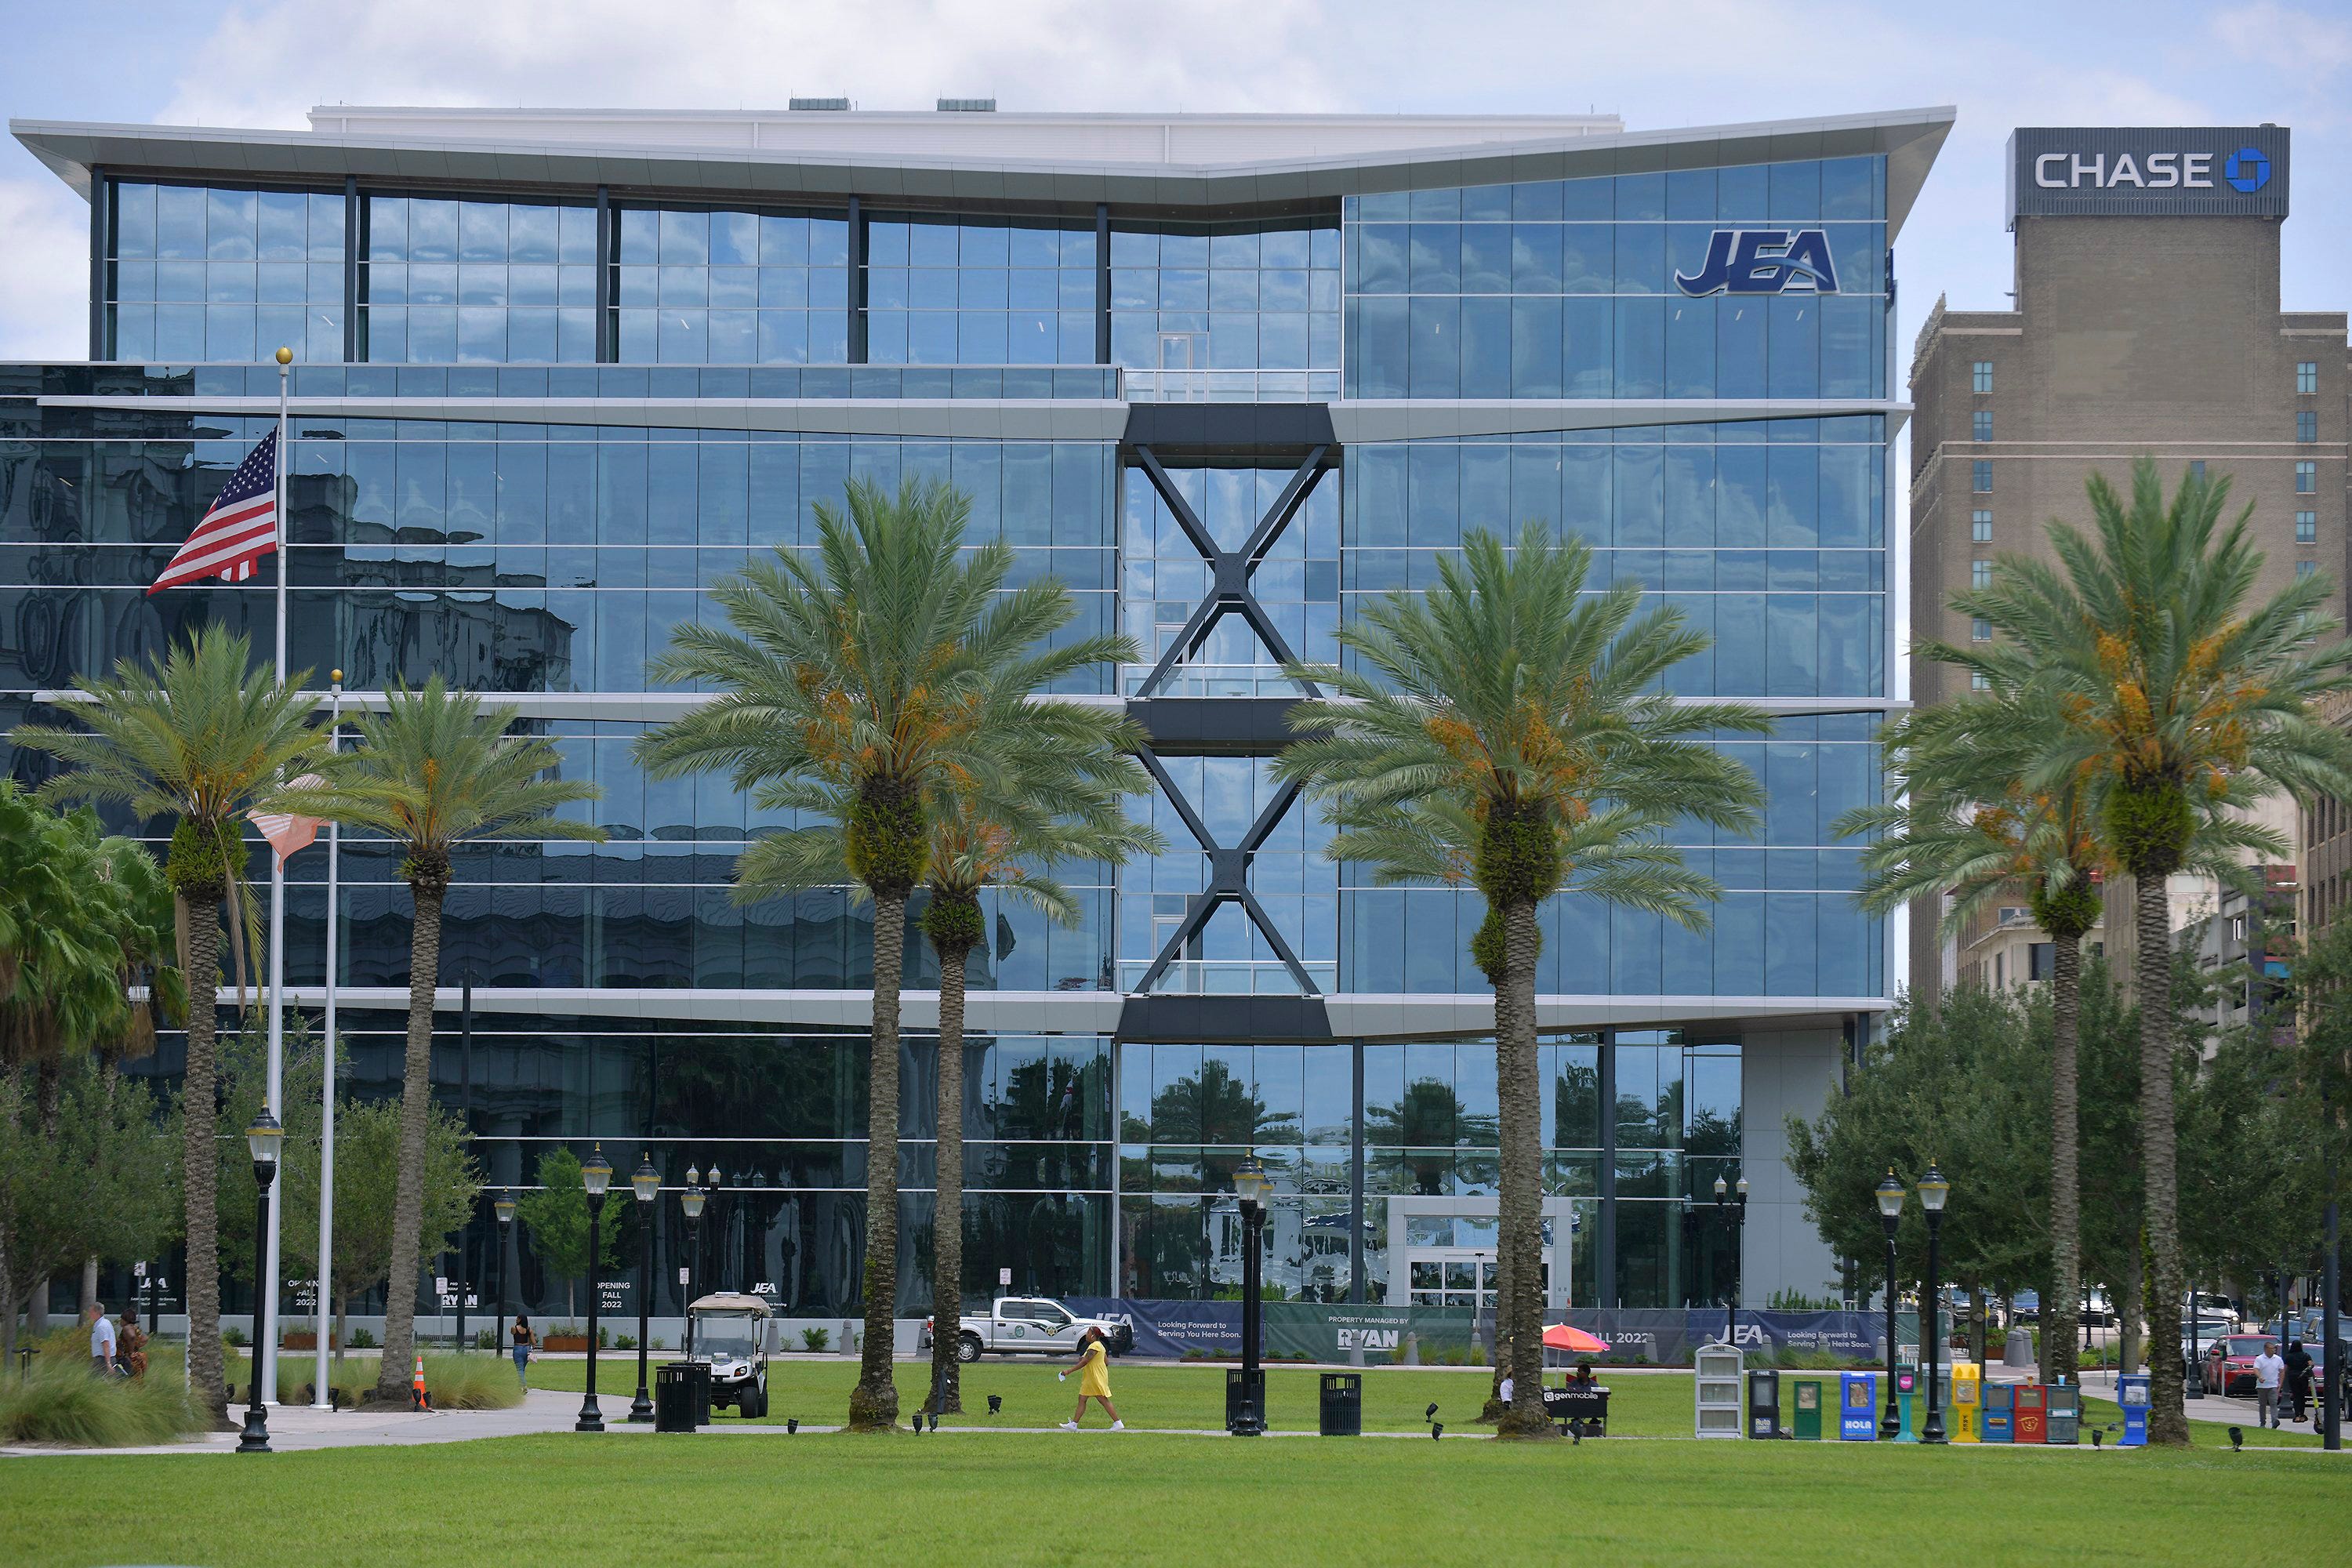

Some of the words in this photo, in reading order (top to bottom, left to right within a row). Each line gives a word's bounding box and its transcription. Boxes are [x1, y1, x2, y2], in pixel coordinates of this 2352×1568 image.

[2035, 153, 2214, 187] CHASE
[1674, 229, 1841, 297] JEA
[140, 1277, 169, 1288] JA
[750, 1283, 776, 1294] JEA
[1157, 1330, 1185, 1338] Serving
[1616, 1333, 1648, 1343] 2022
[1714, 1325, 1763, 1345] JEA
[1554, 1392, 1599, 1401] genmobile
[1845, 1420, 1872, 1429] HOLA
